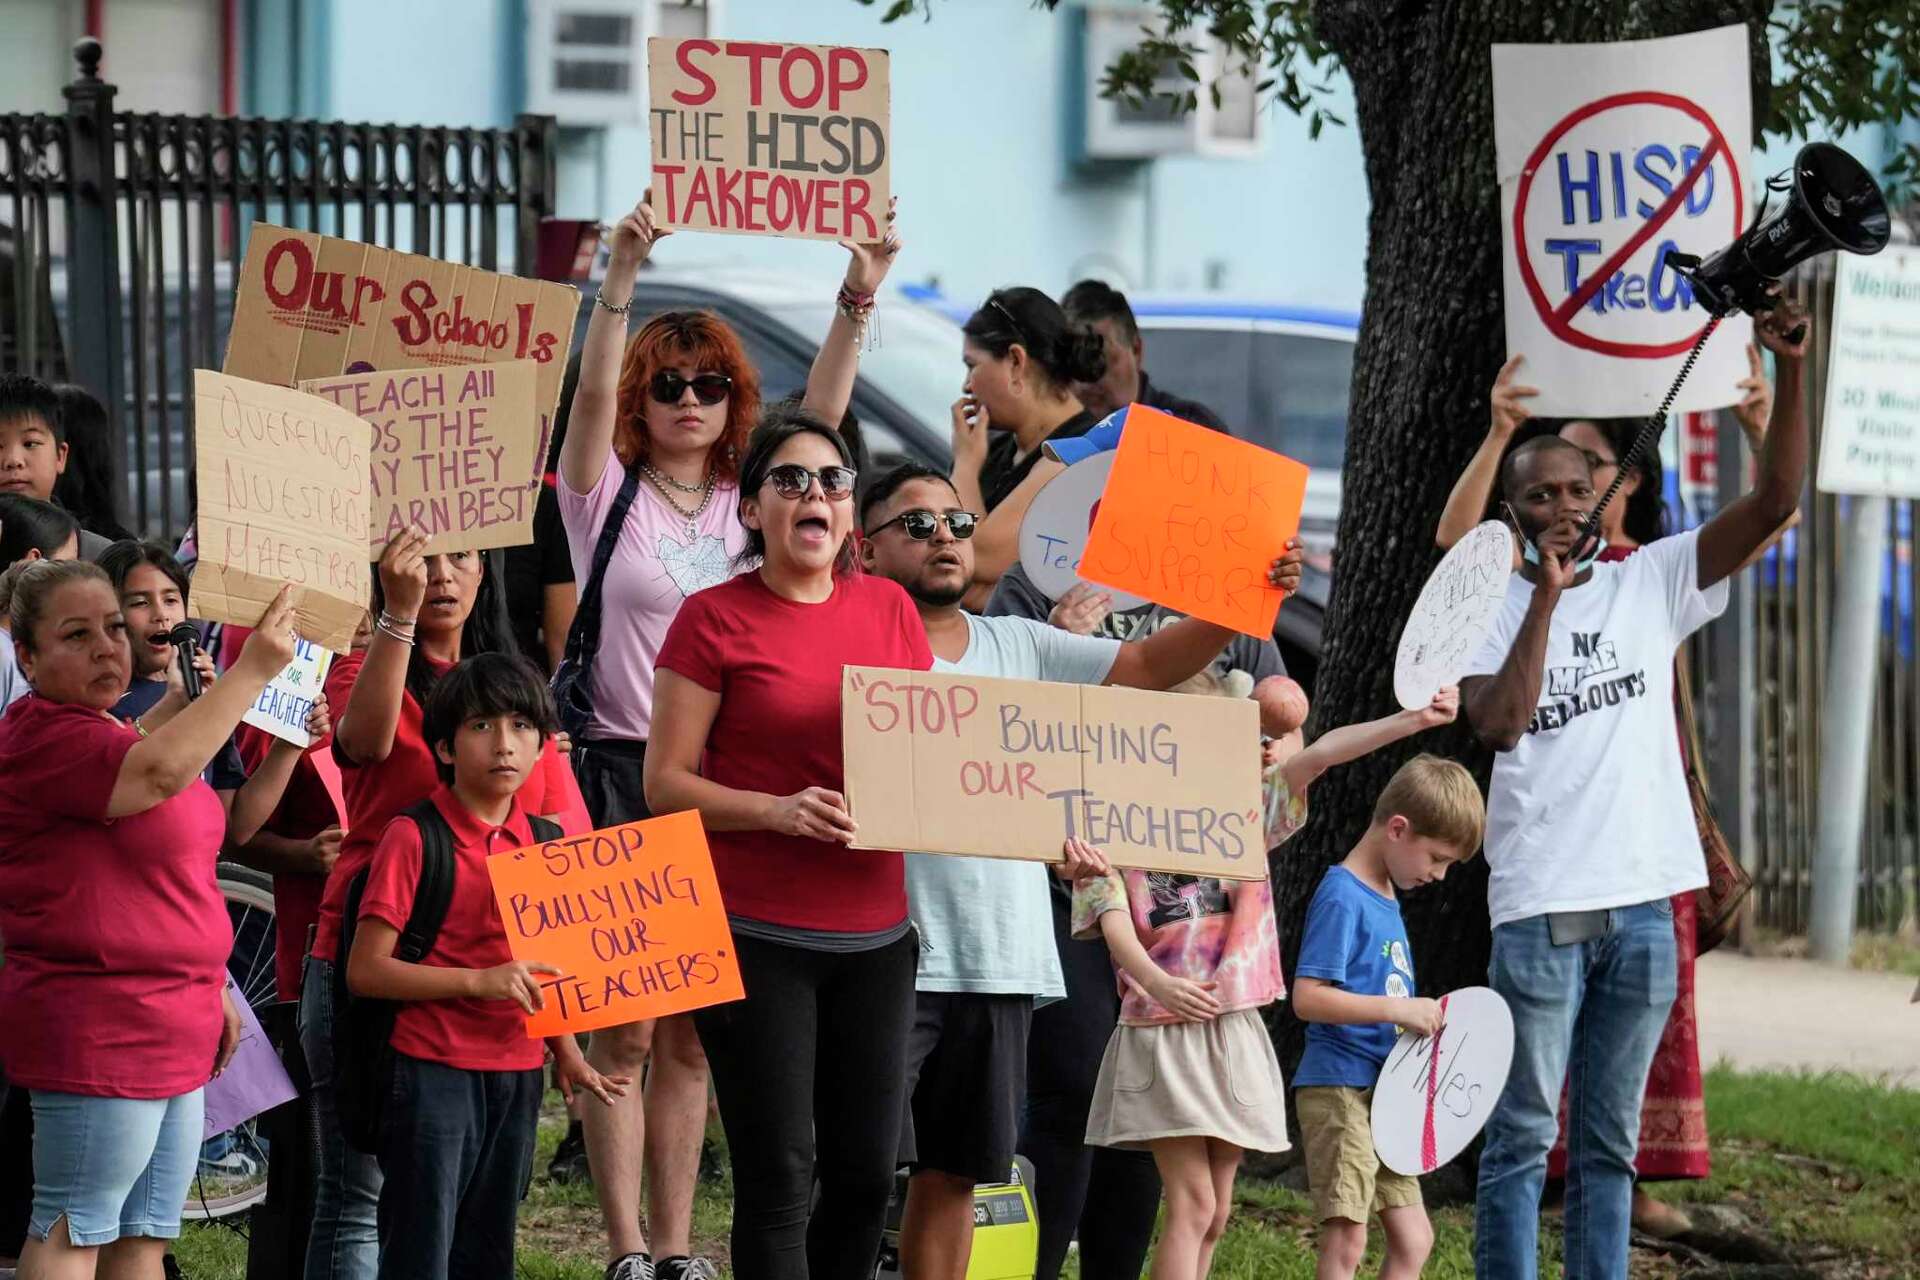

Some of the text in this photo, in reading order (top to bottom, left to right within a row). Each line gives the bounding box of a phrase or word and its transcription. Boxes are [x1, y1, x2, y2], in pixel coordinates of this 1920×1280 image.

[671, 39, 868, 111] STOP
[650, 109, 885, 175] THE HISD
[653, 165, 877, 238] TAKEOVER
[1557, 144, 1714, 225] HISD
[1768, 218, 1790, 242] PYLE
[264, 238, 558, 362] Our Schools
[408, 408, 493, 450] THE
[412, 446, 504, 491] THEY
[1147, 432, 1274, 511] HONK
[370, 497, 450, 545] ARN
[1165, 504, 1250, 551] FOR
[1098, 521, 1282, 626] SUPPORT
[287, 666, 302, 686] OUR
[251, 685, 314, 731] EACHER
[959, 761, 1046, 800] OUR
[510, 864, 699, 937] BULLYING
[592, 918, 666, 962] OUR
